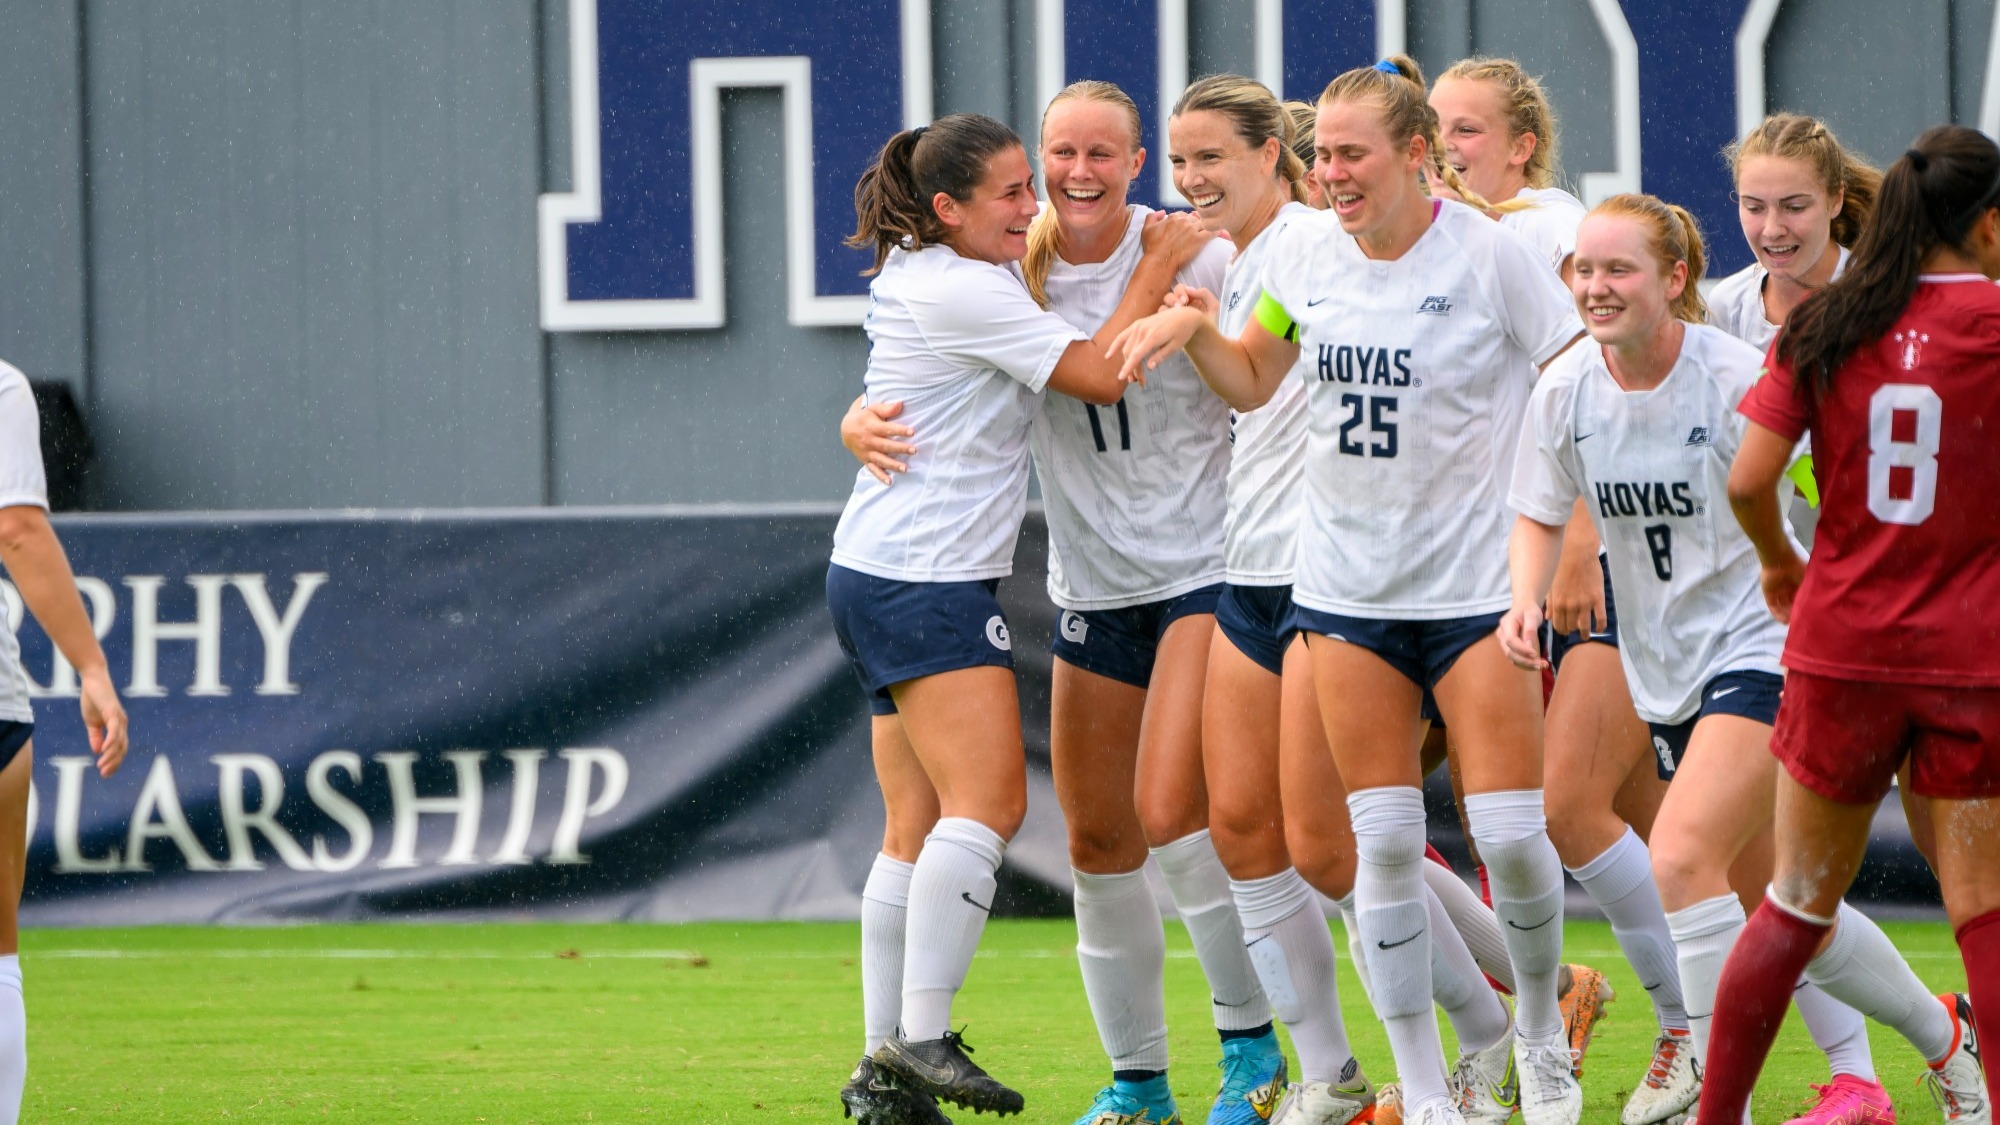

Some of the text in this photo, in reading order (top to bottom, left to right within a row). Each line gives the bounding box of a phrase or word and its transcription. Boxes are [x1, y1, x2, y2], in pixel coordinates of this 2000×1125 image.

[1420, 303, 1454, 311] EAST
[1424, 295, 1448, 304] BIG
[1318, 343, 1411, 387] HOYAS
[1339, 393, 1399, 459] 25
[1867, 382, 1942, 526] 8
[1595, 482, 1694, 518] HOYAS
[1644, 523, 1673, 581] 8
[985, 615, 1012, 651] G
[1060, 609, 1090, 645] G
[27, 747, 630, 873] LARSHIP
